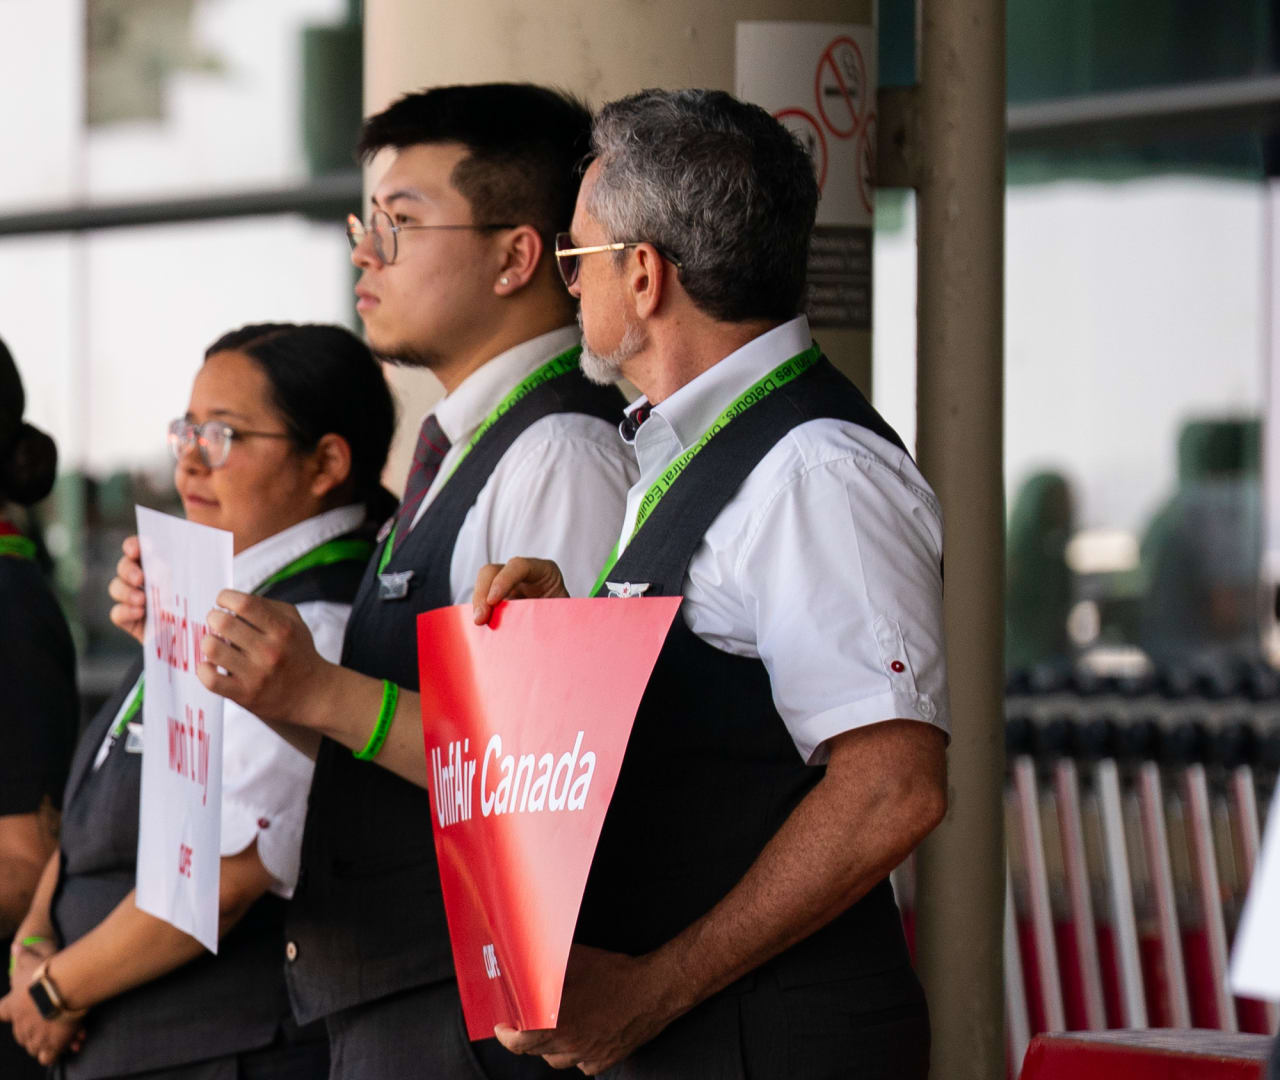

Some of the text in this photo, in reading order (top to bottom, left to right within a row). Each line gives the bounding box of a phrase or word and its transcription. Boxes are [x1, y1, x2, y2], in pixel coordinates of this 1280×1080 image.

[776, 365, 798, 381] les
[151, 584, 189, 686] Unpaid
[167, 704, 210, 806] won't fly
[432, 731, 596, 828] UnfAir Canada
